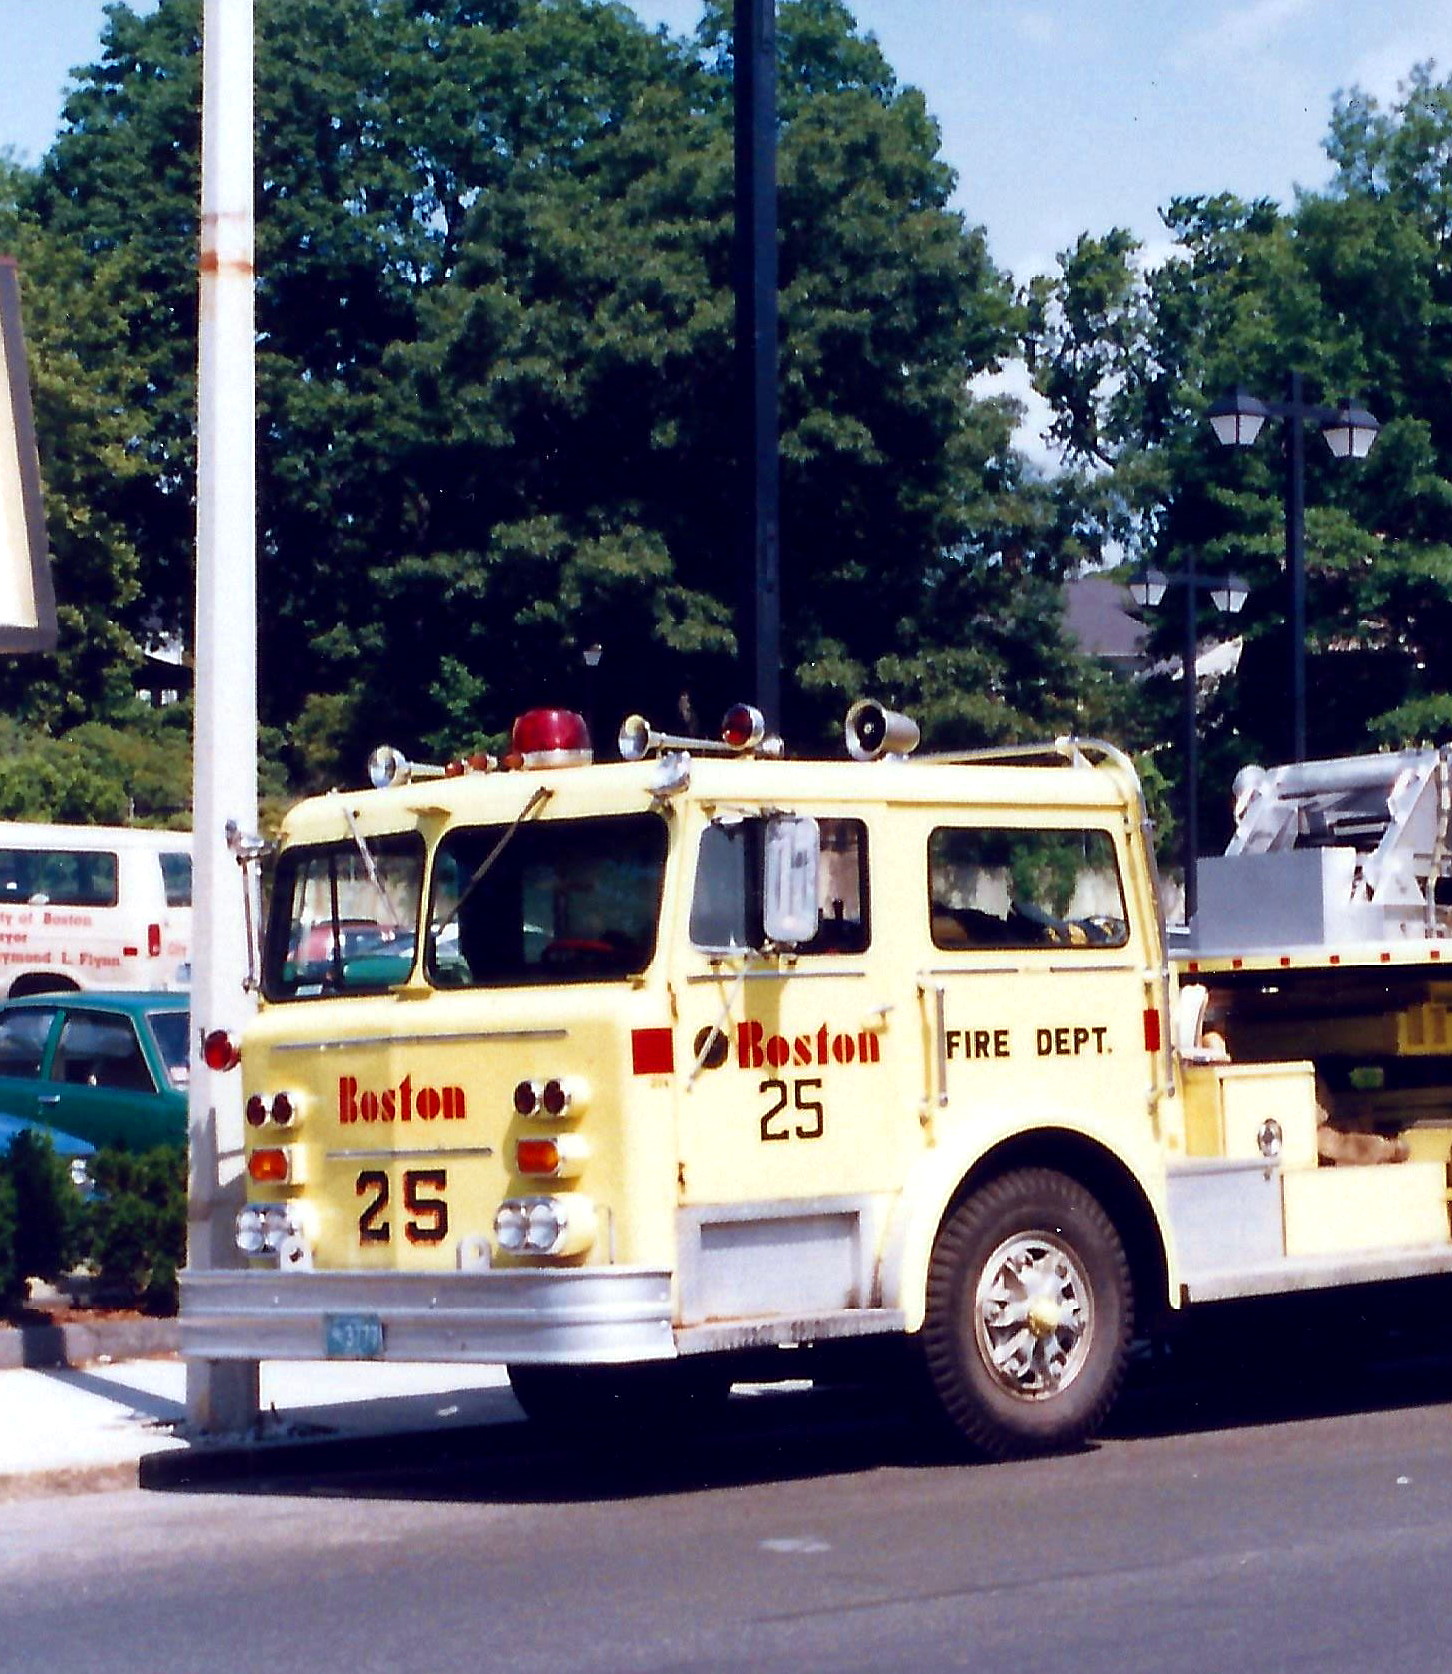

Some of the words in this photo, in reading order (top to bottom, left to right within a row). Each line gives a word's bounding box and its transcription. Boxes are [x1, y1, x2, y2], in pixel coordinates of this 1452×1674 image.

[44, 912, 92, 926] Boston
[80, 953, 120, 968] Flynn
[737, 1020, 881, 1069] Boston
[946, 1029, 1010, 1059] FIRE
[1036, 1026, 1113, 1056] DEPT.
[339, 1073, 467, 1124] Boston
[759, 1078, 824, 1142] 25
[355, 1168, 449, 1247] 25
